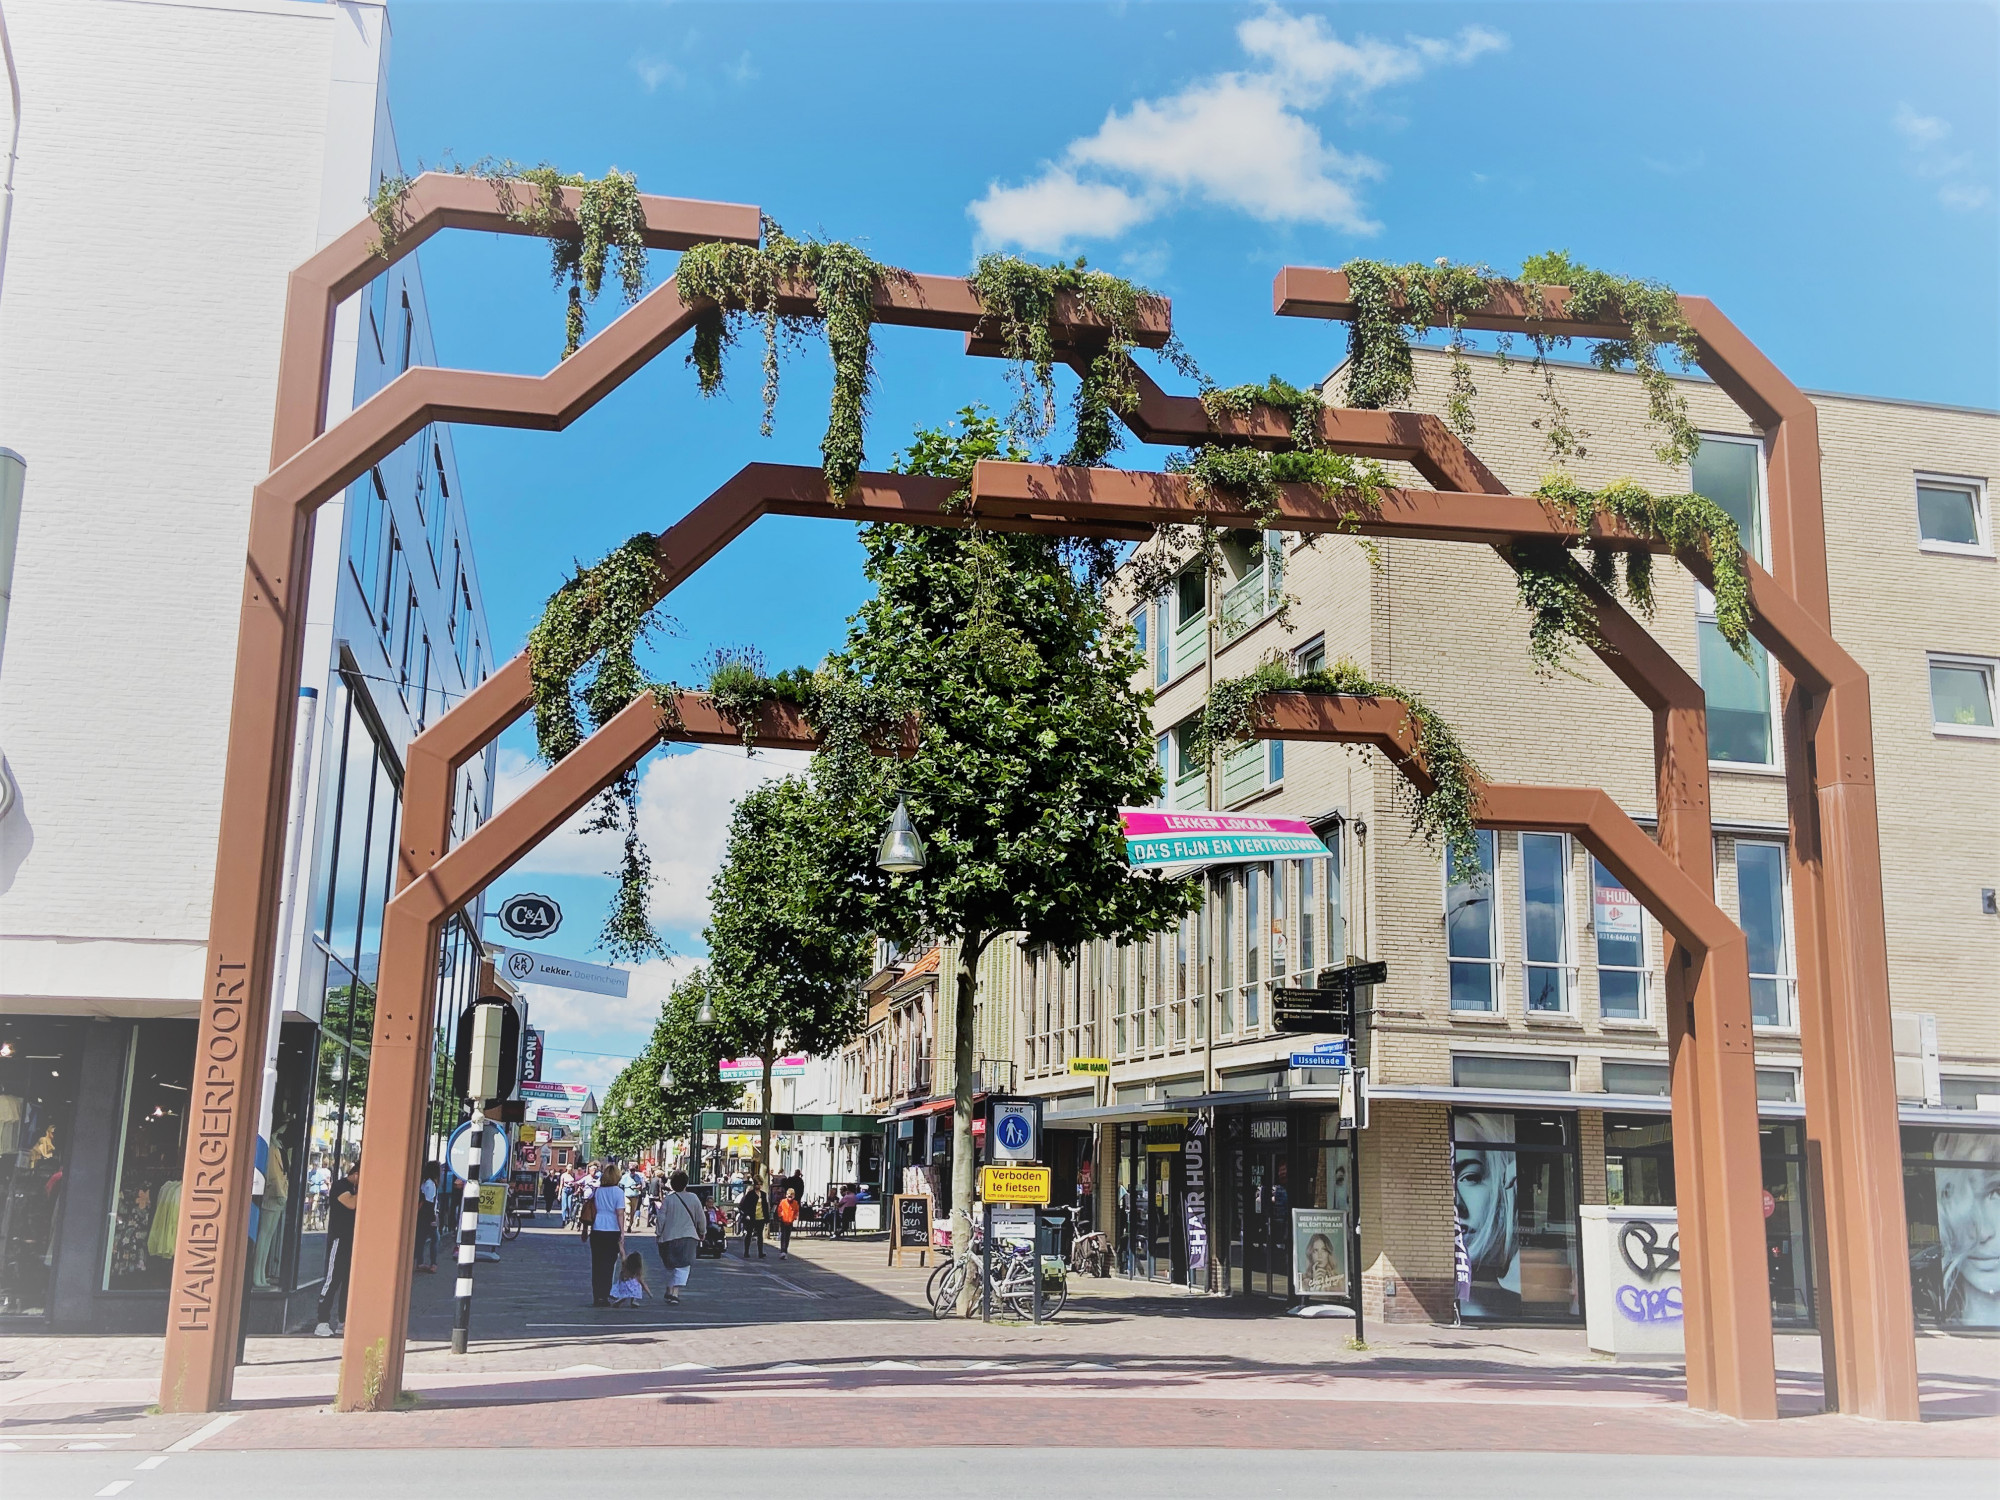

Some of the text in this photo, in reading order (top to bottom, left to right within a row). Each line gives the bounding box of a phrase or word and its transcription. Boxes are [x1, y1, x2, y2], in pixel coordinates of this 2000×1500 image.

[1164, 816, 1276, 831] LEKKER LOKAAL
[1134, 838, 1322, 860] DA'S FIJN EN VERTROUWD
[511, 905, 550, 926] C&A
[540, 964, 572, 977] Lekker.
[1298, 1056, 1340, 1065] IJsselkade
[727, 1117, 762, 1126] LUNCHRO
[1253, 1121, 1287, 1138] HAIR HUB
[178, 953, 248, 1333] HAMBURGERPOORT
[992, 1170, 1042, 1181] Verboden
[992, 1182, 1041, 1193] te fietsen
[1185, 1139, 1207, 1246] HAIR HUB
